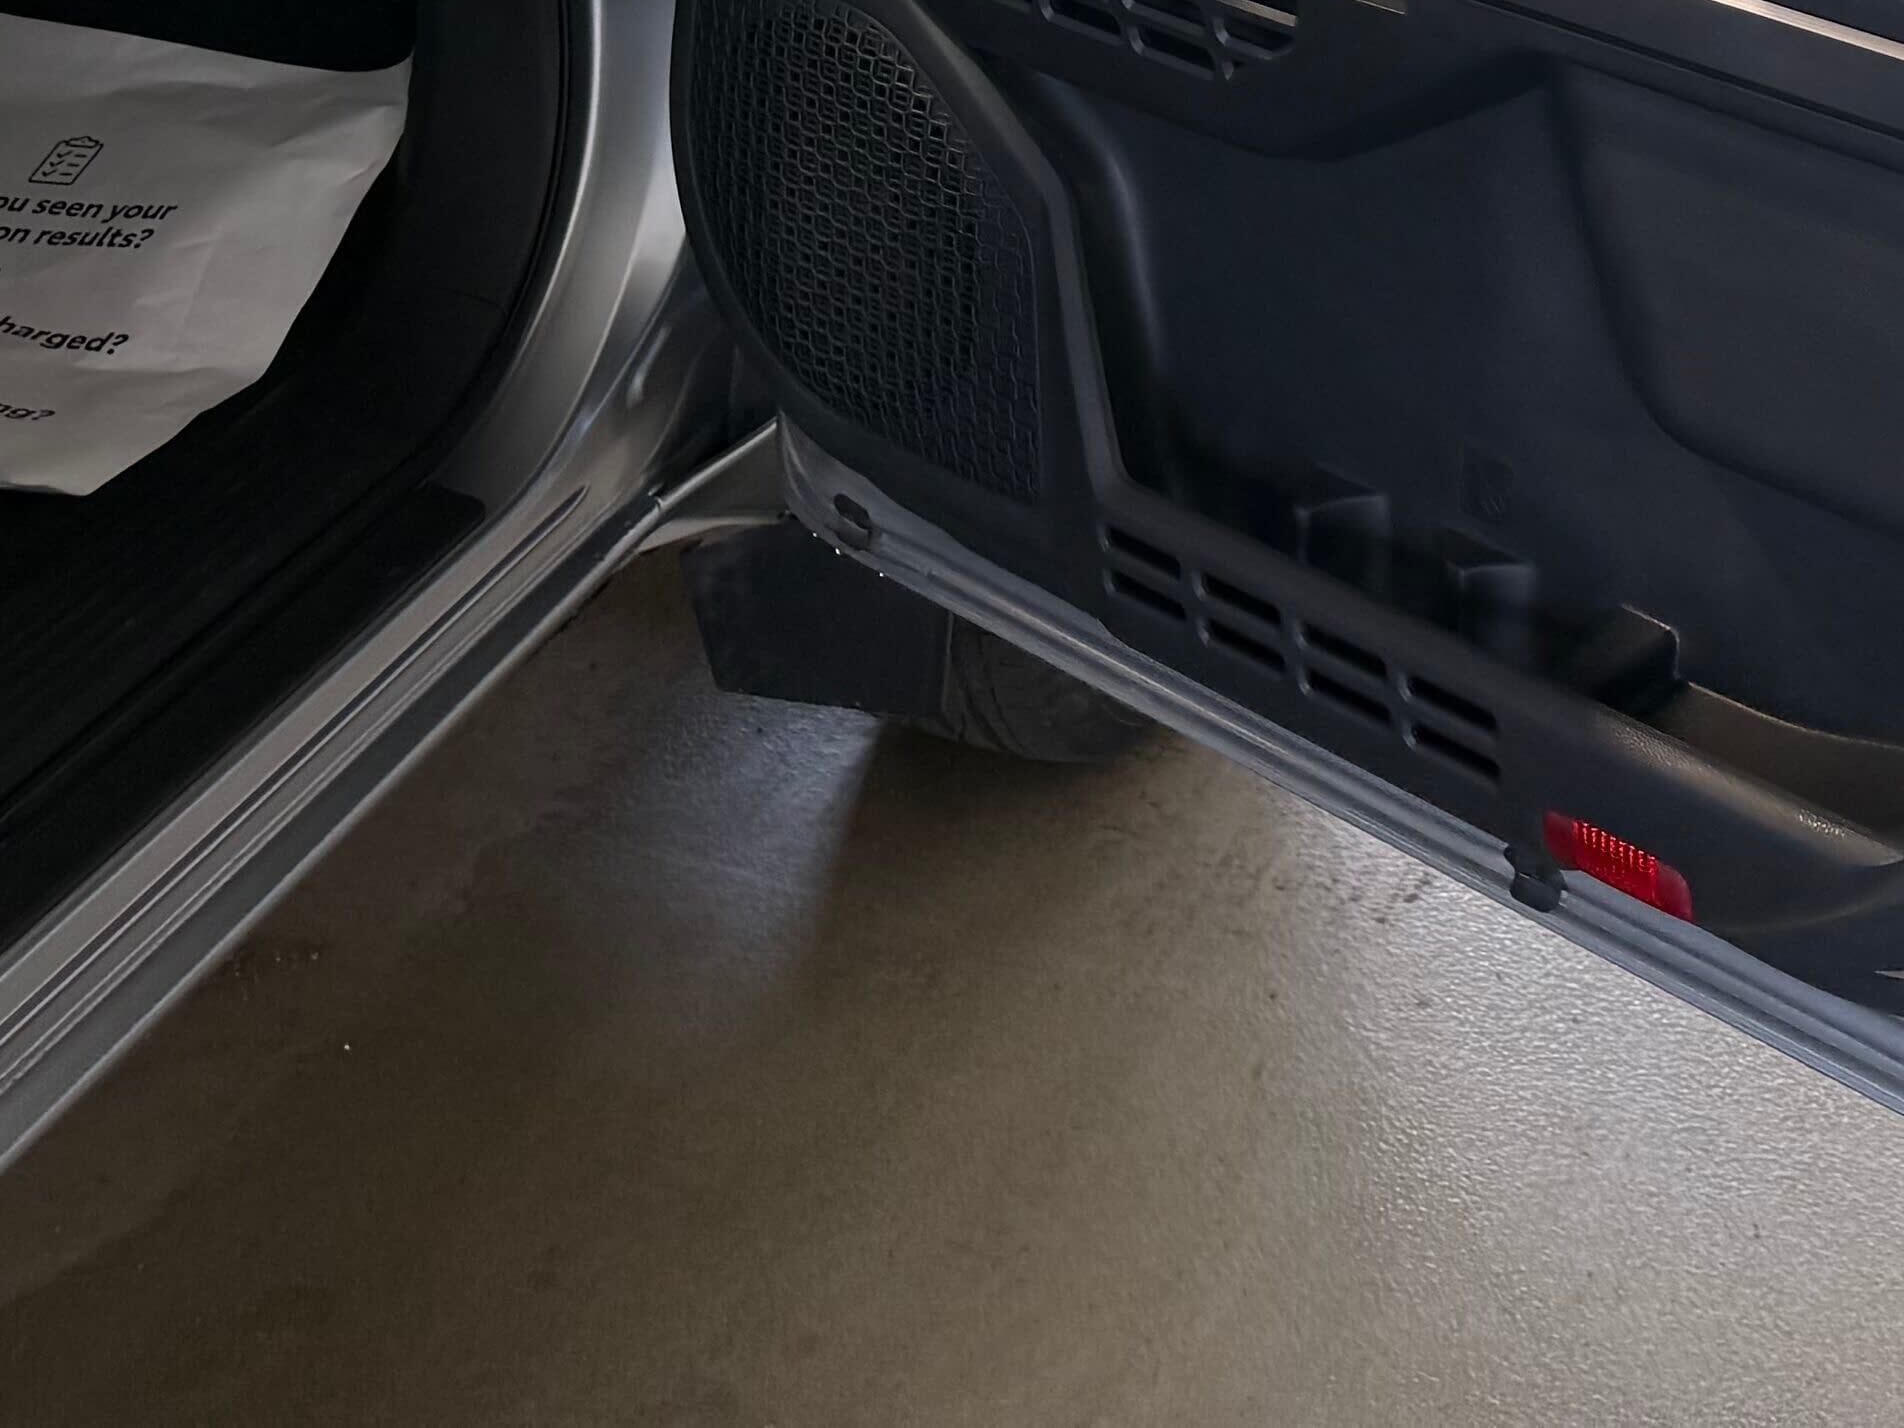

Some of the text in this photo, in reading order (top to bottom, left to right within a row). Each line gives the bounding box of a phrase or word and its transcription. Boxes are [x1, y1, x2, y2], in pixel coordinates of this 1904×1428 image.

[32, 196, 104, 219] seen
[100, 202, 178, 224] your
[32, 227, 155, 249] results?
